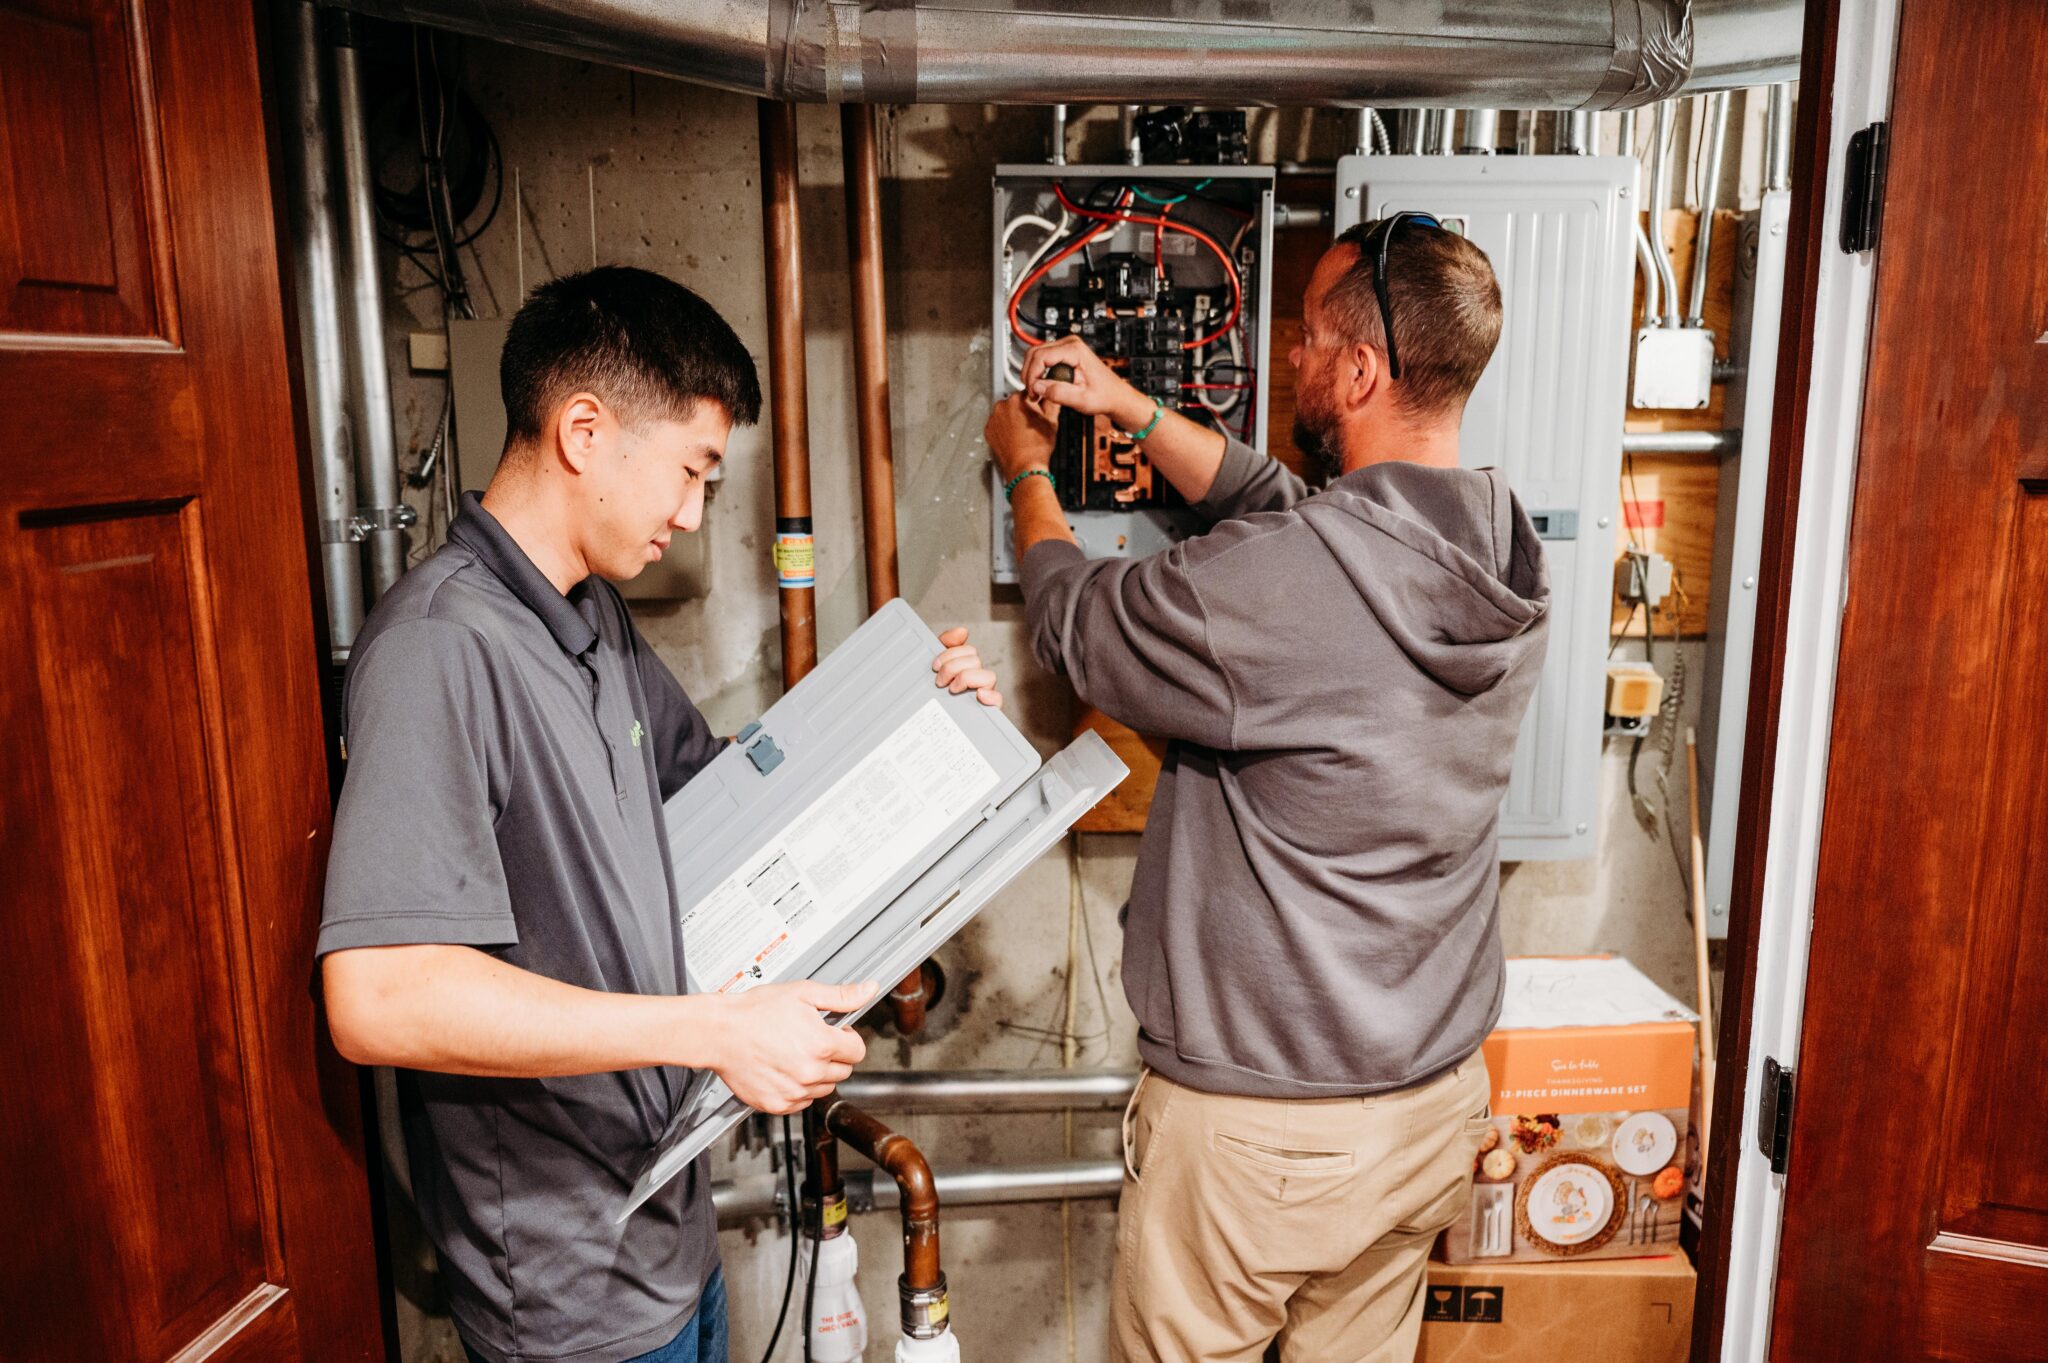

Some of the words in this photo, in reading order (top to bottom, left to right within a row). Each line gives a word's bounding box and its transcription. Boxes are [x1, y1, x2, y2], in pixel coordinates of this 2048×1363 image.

[1500, 1089, 1547, 1099] 12-PIECE
[1550, 1086, 1624, 1097] DINNERWARE
[1627, 1085, 1648, 1094] SET
